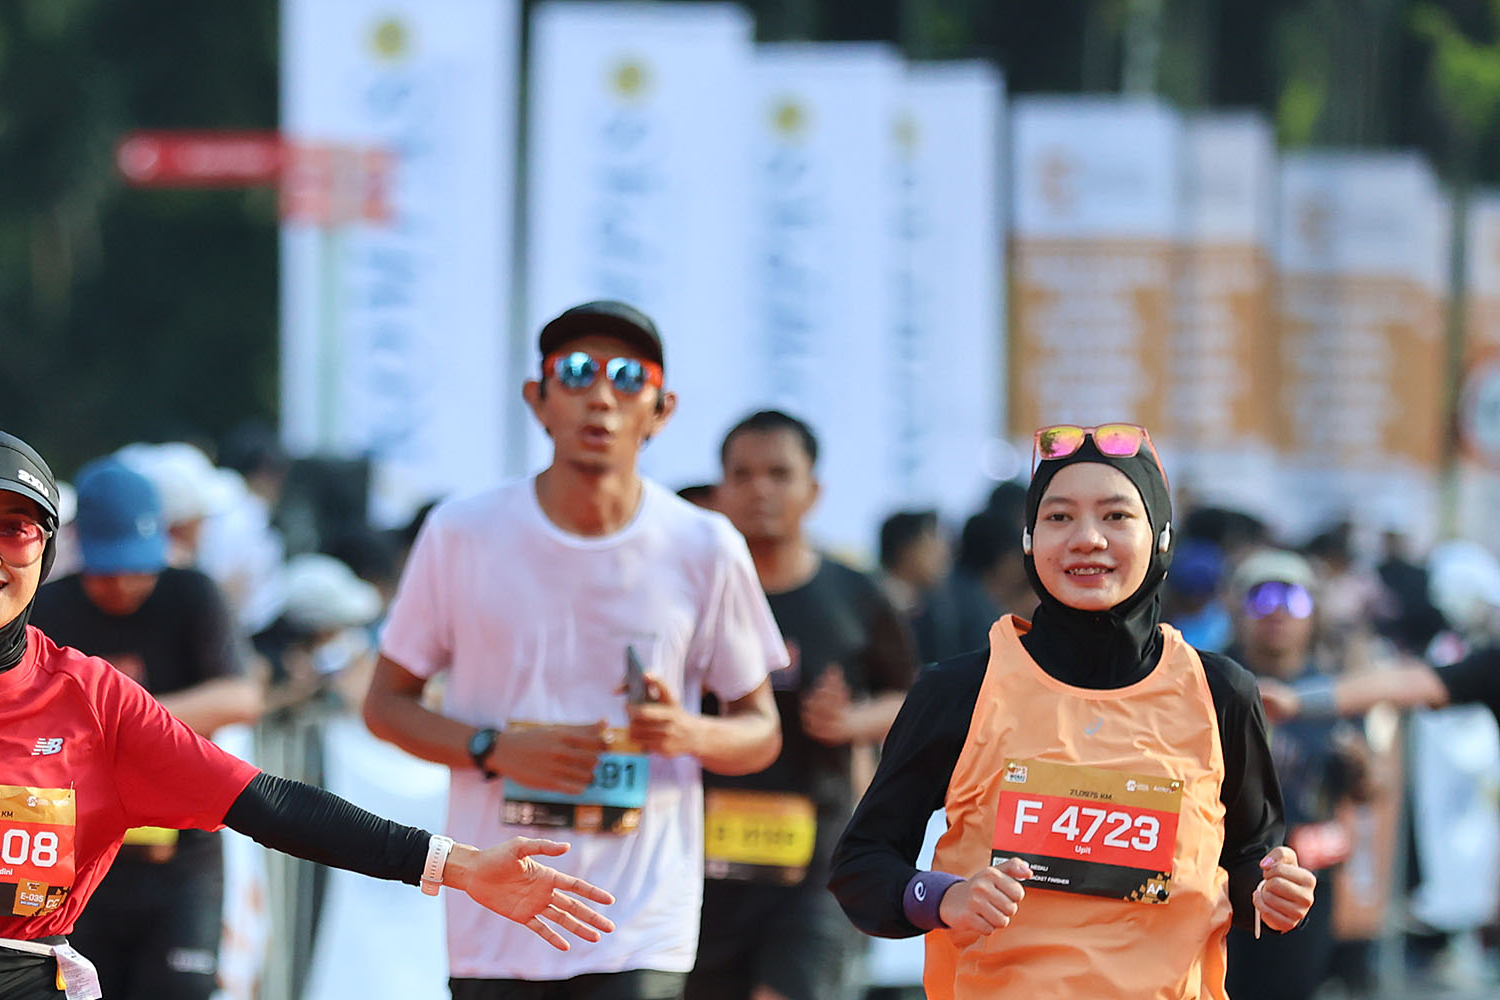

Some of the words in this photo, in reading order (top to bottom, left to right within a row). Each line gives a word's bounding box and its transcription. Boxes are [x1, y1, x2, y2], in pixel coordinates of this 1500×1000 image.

[1, 810, 14, 818] KM
[1013, 799, 1044, 835] F
[1051, 805, 1160, 852] 4723
